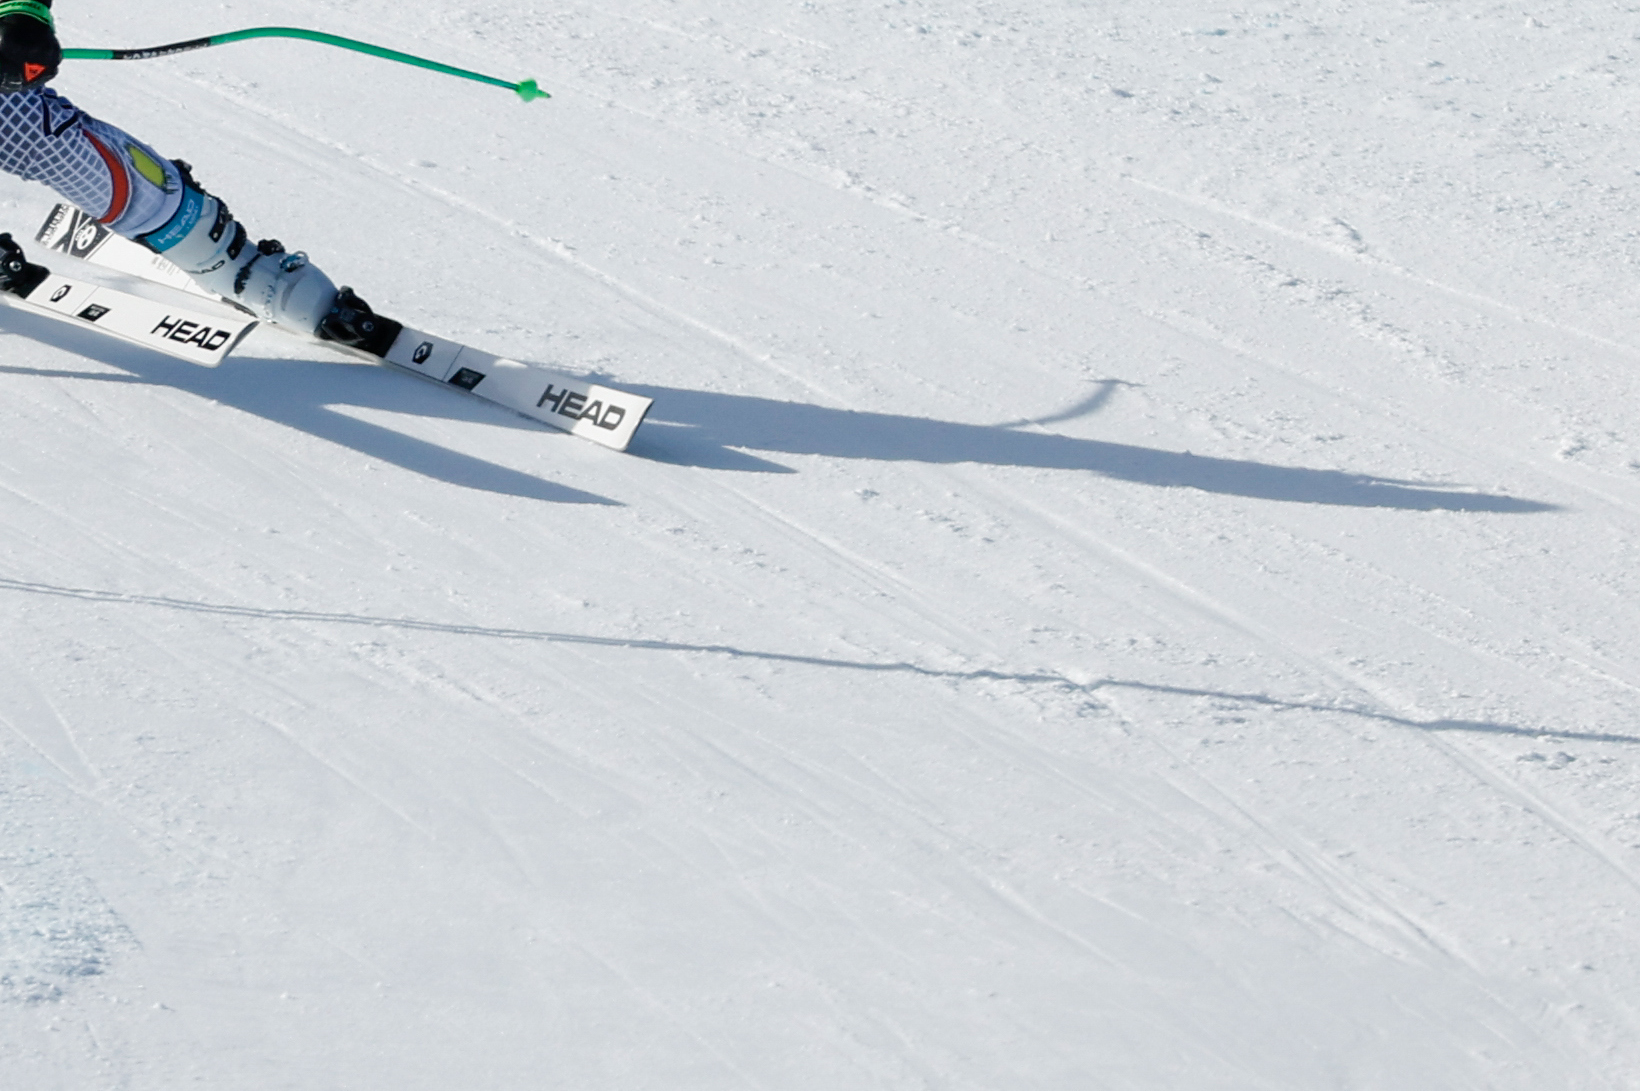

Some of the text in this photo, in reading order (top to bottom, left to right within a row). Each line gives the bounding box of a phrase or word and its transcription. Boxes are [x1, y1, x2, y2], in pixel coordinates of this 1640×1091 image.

[157, 198, 195, 244] HEAD
[150, 314, 232, 351] HEAD
[536, 383, 627, 431] HEAD
